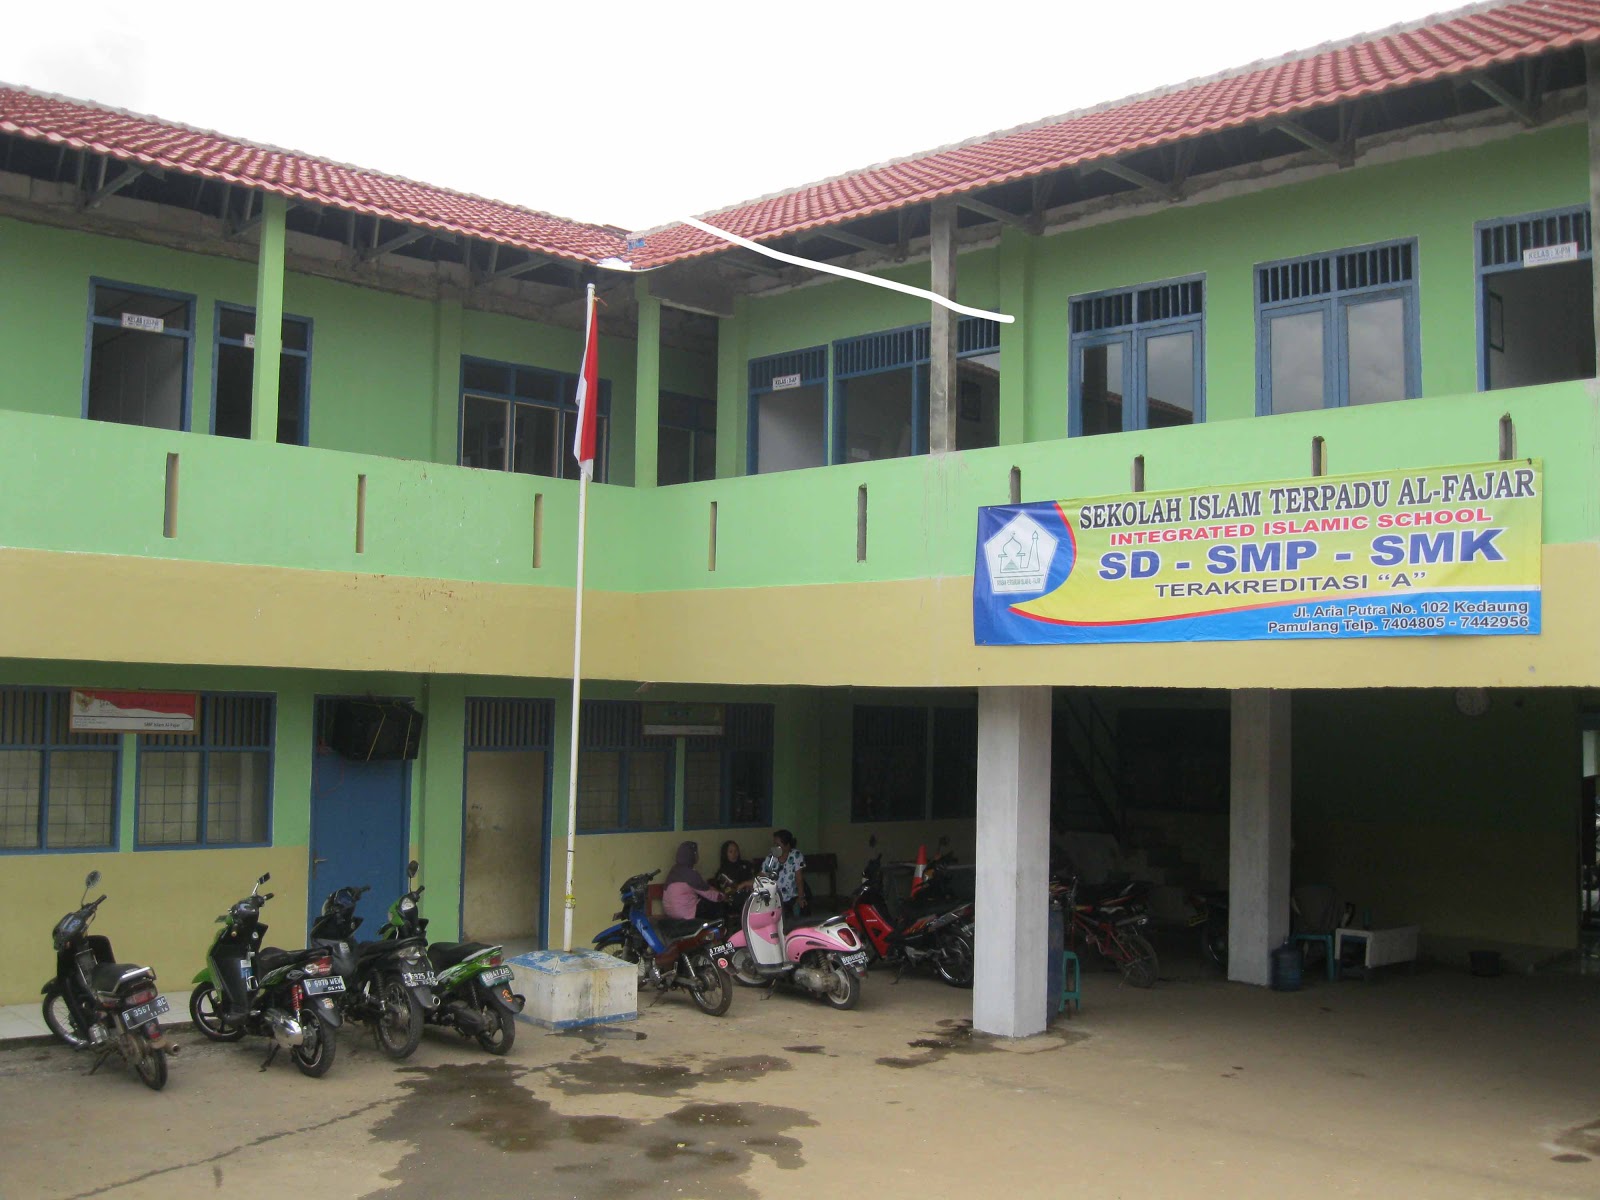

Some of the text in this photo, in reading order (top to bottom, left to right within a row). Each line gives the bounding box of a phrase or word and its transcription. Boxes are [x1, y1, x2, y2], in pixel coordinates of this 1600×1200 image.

[1080, 469, 1536, 530] SEKOLAH ISLAM TERPADU AL-FAJAR
[1110, 508, 1492, 546] INTEGRATED ISLAMIC SCHOOL
[1099, 528, 1506, 581] SD - SMP - SMK
[1155, 575, 1368, 598] TERAKREDITASI
[1314, 605, 1343, 617] Aria
[1348, 604, 1387, 616] Putra
[1391, 603, 1417, 615] No.
[1421, 602, 1449, 614] 102
[1454, 601, 1529, 615] Kedaung
[1268, 621, 1339, 633] Pamulang
[1343, 619, 1379, 633] Telp.
[1382, 617, 1445, 630] 7404805
[1461, 615, 1529, 628] 7442956
[124, 1013, 130, 1021] B
[133, 1004, 151, 1017] 3567
